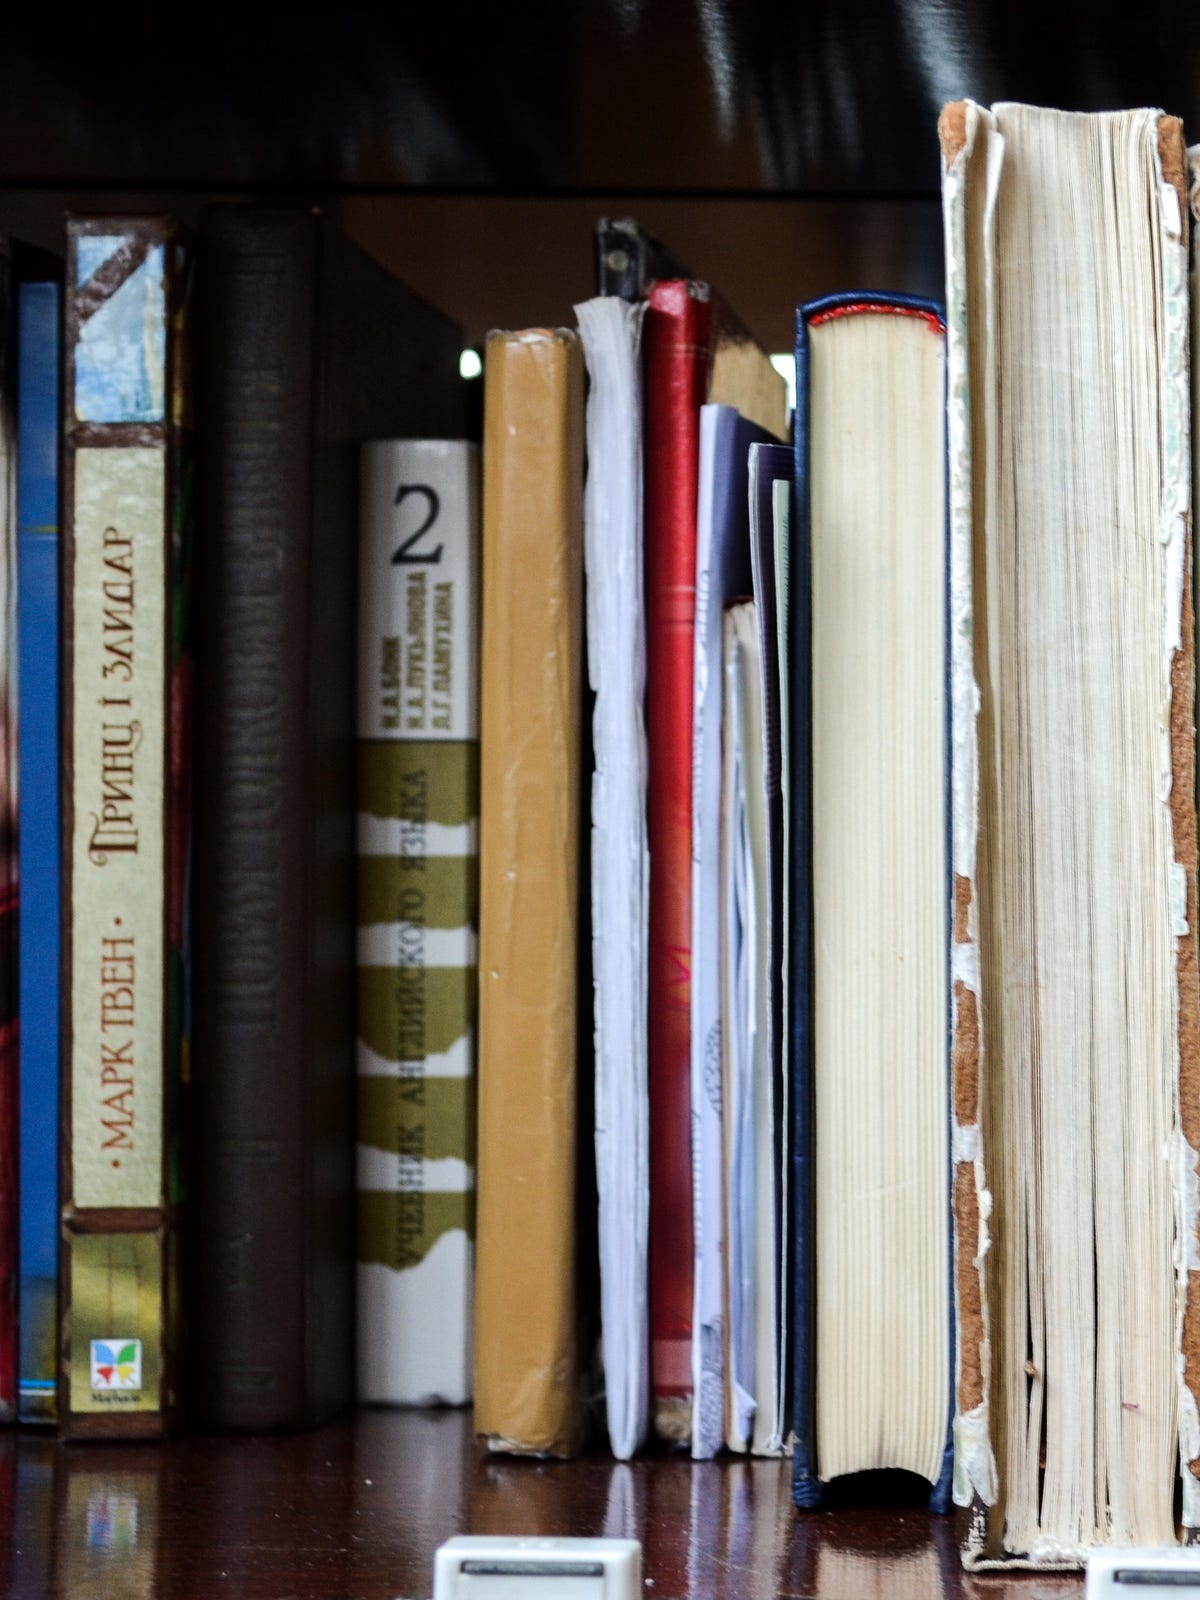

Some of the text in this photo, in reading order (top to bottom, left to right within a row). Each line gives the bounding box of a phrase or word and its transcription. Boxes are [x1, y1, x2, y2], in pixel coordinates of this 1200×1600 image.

[391, 483, 444, 566] 2
[100, 936, 134, 1151] МАРК ТВЕН
[396, 769, 427, 1265] УЧЕБНИК АНГЛИЙСКОГО ЯЗЫКА
